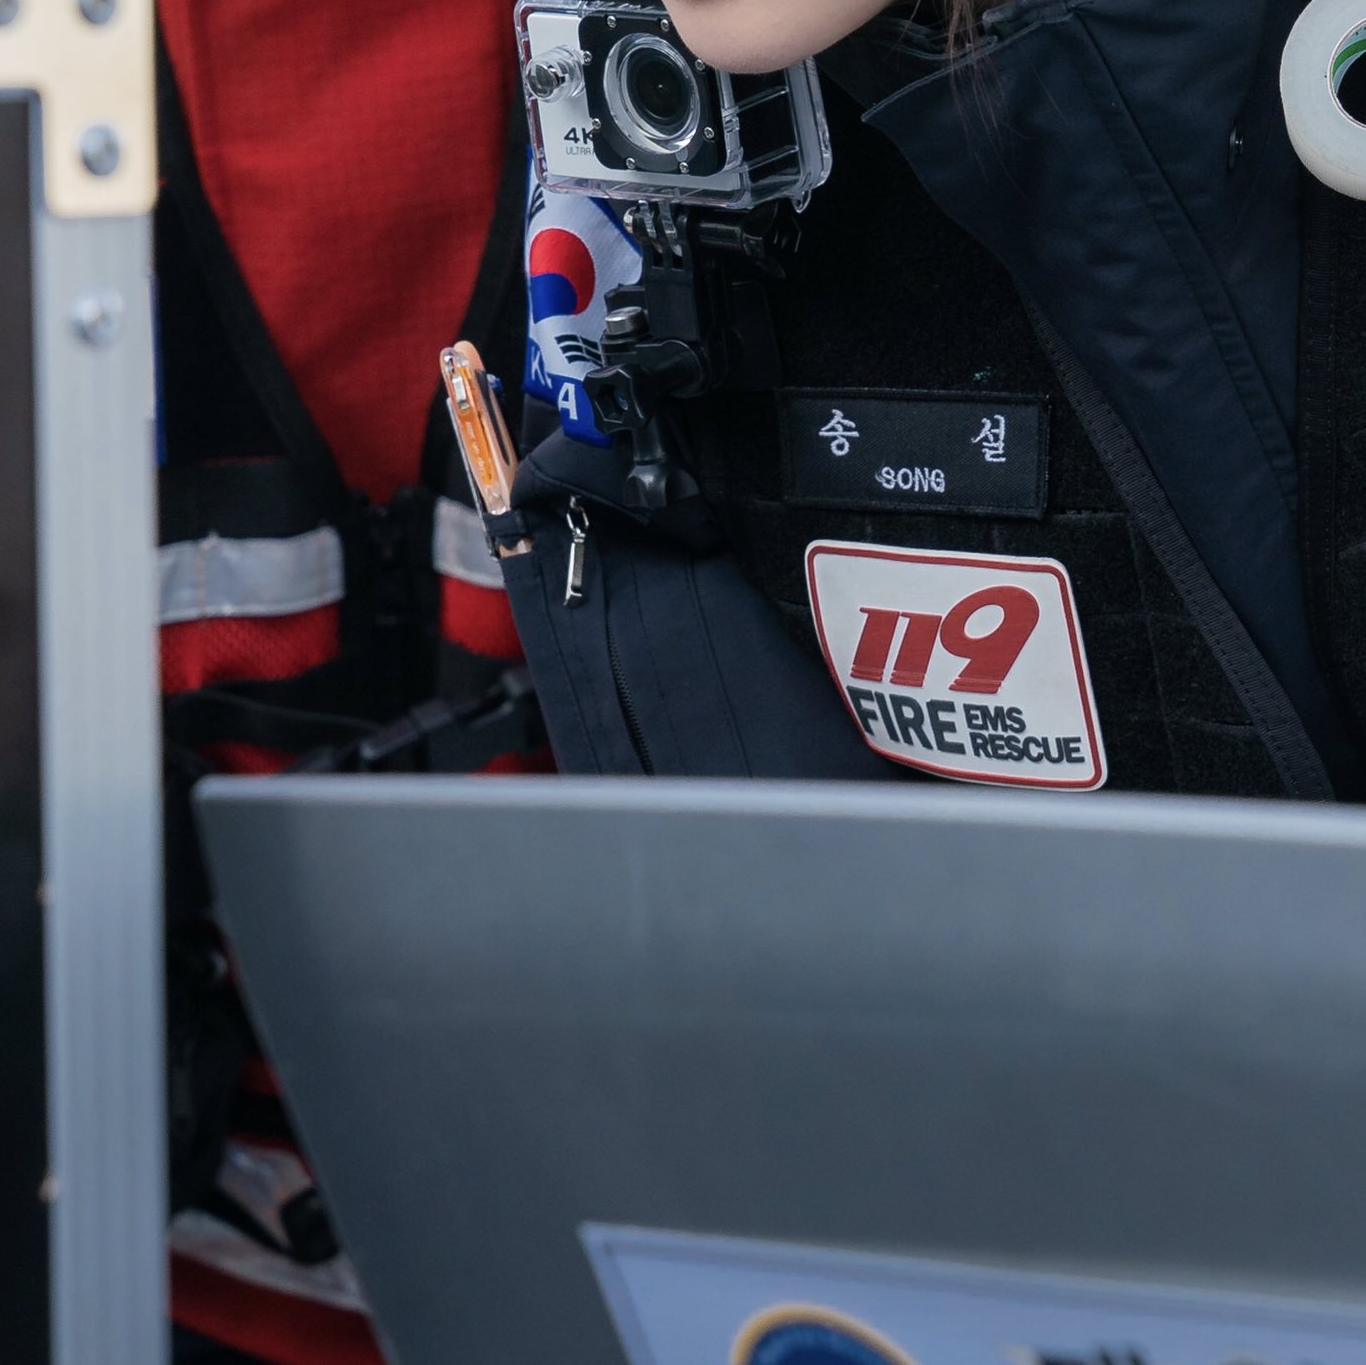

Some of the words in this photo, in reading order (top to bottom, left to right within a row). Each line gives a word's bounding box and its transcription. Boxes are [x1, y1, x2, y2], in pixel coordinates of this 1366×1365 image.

[565, 146, 592, 156] ULTRA
[878, 466, 946, 493] SONG
[849, 584, 1041, 695] 119
[846, 684, 968, 756] FIRE
[963, 702, 1027, 734] EMS
[968, 731, 1086, 765] RESCUE
